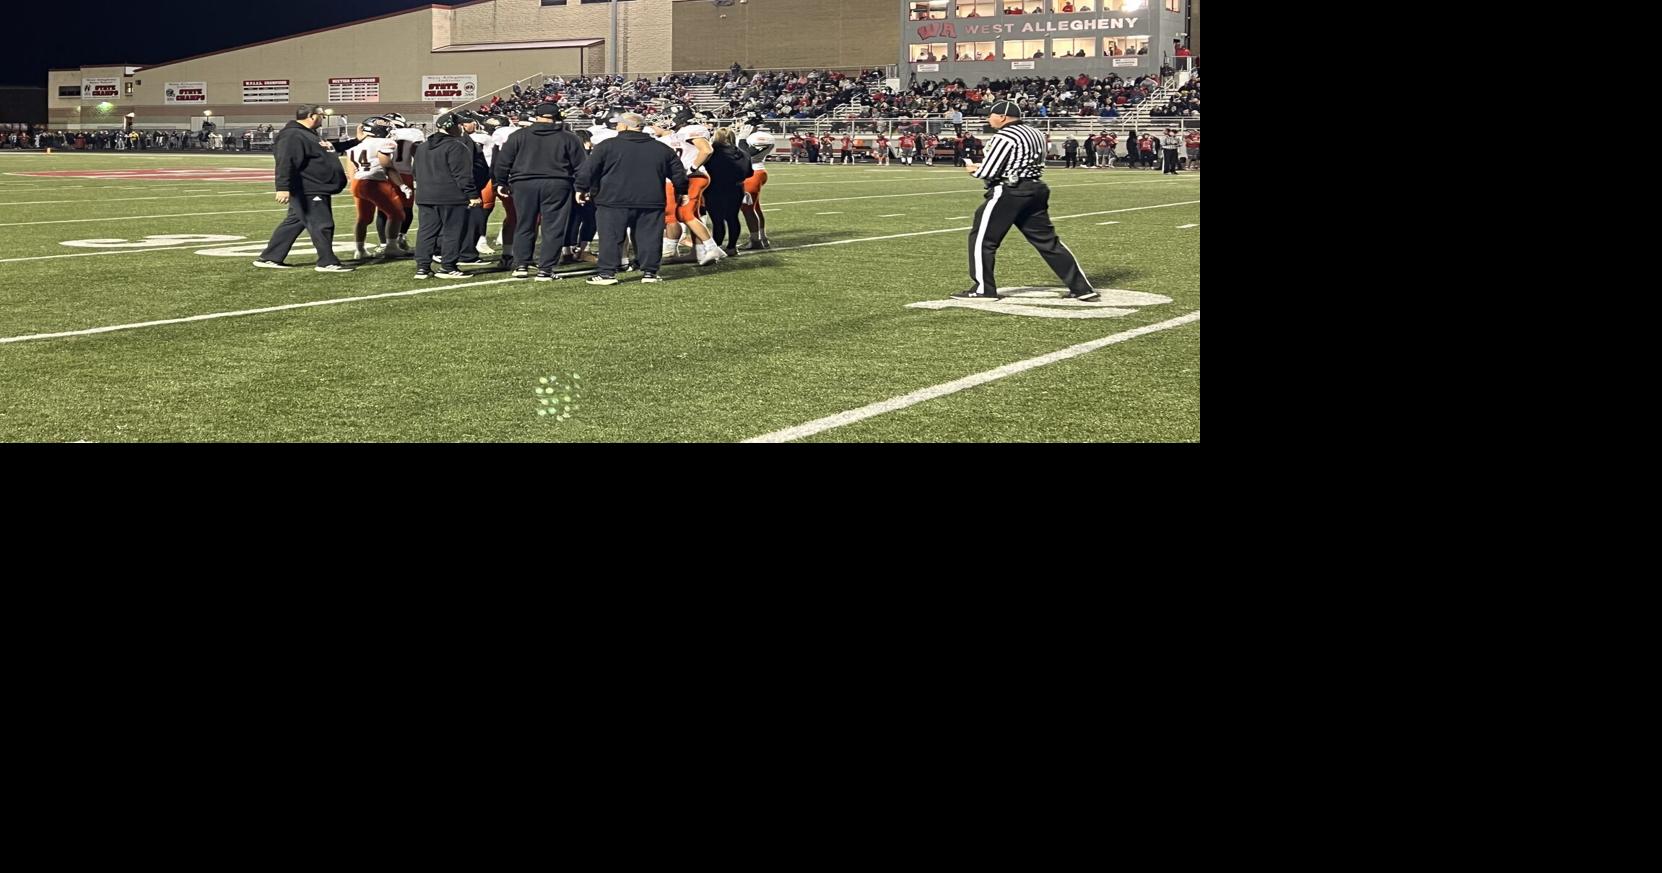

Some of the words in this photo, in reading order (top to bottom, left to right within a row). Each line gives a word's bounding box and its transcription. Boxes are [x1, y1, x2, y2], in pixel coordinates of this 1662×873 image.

[917, 22, 957, 40] WA
[964, 23, 1014, 34] WEST
[1021, 17, 1138, 33] ALLEGHENY
[350, 149, 371, 171] 14
